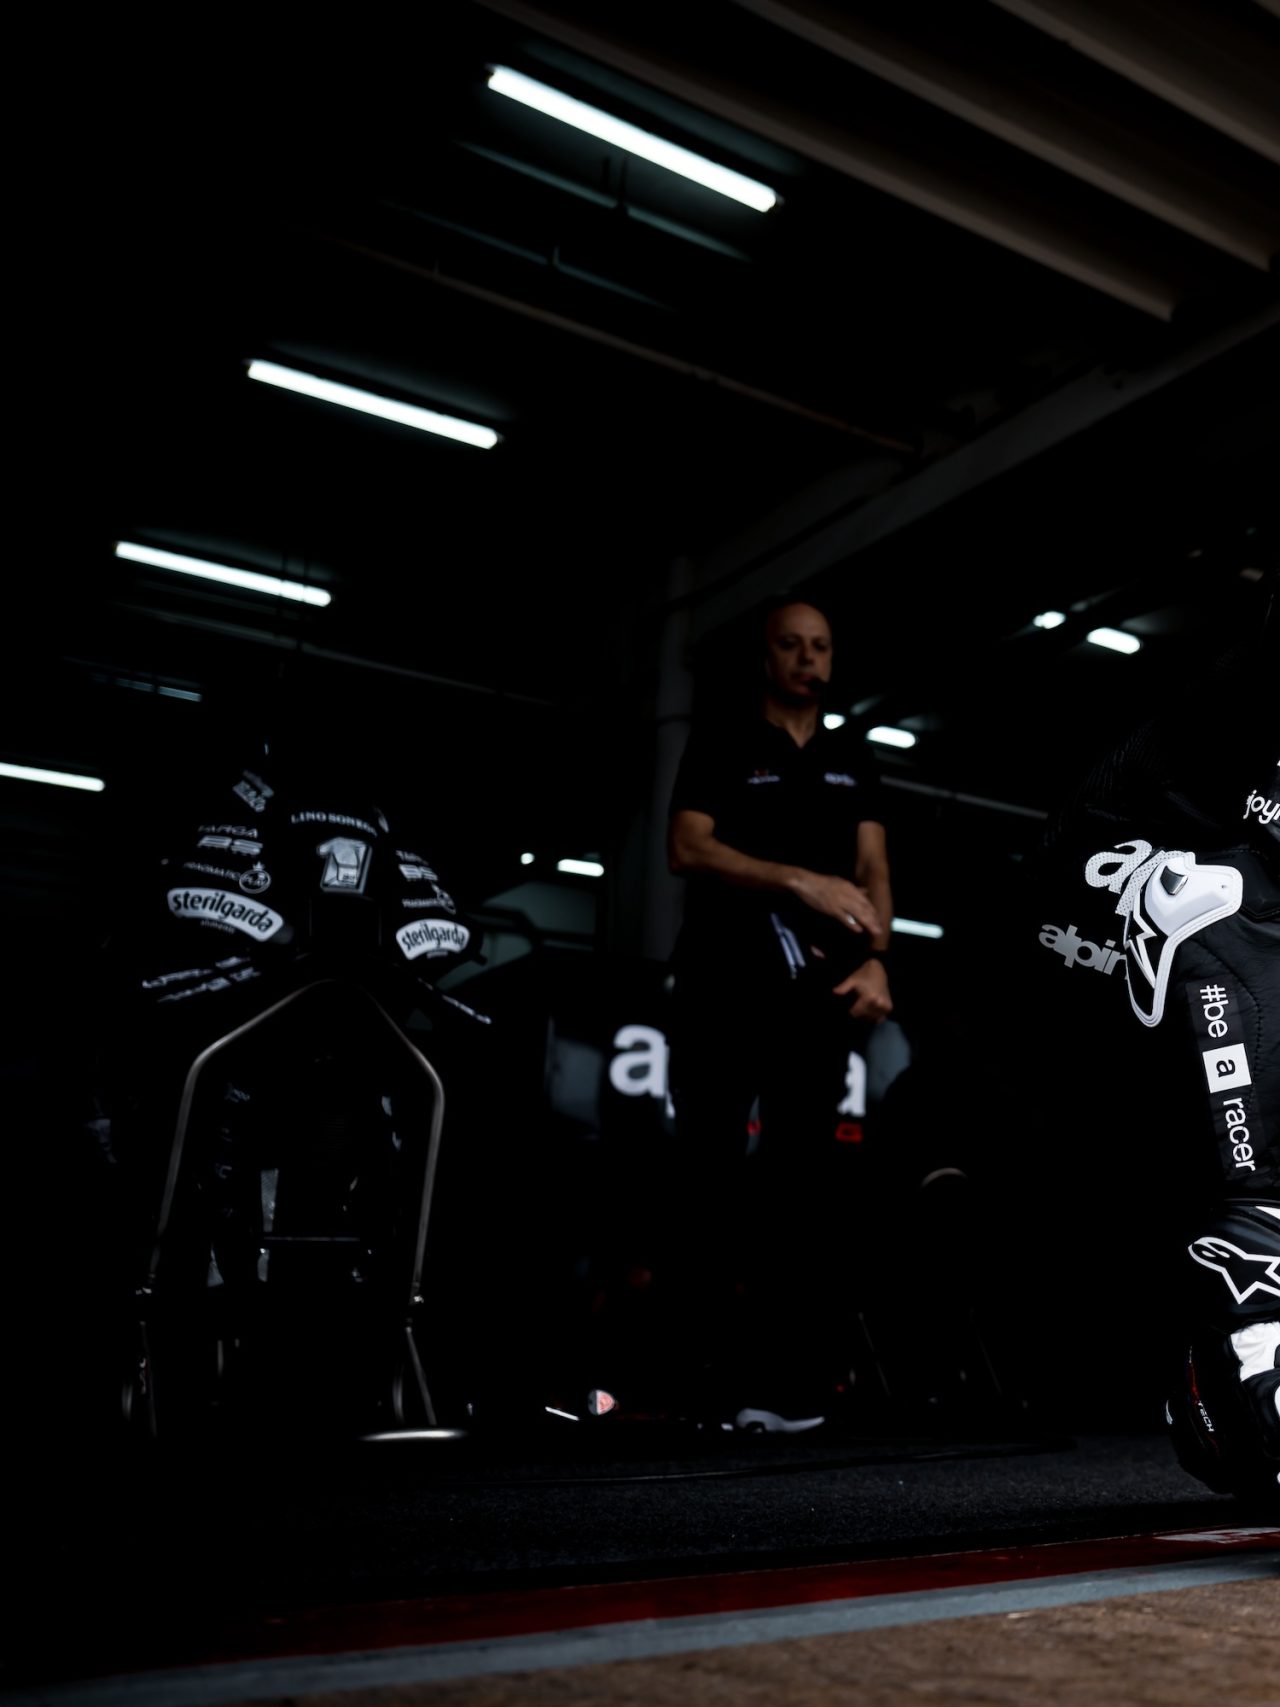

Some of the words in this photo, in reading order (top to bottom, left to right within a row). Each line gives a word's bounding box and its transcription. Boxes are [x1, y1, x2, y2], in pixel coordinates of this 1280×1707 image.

[172, 891, 274, 933] sterilgarda
[402, 922, 466, 951] sterilgarda
[1199, 983, 1229, 1039] #be
[1222, 1097, 1257, 1172] racer
